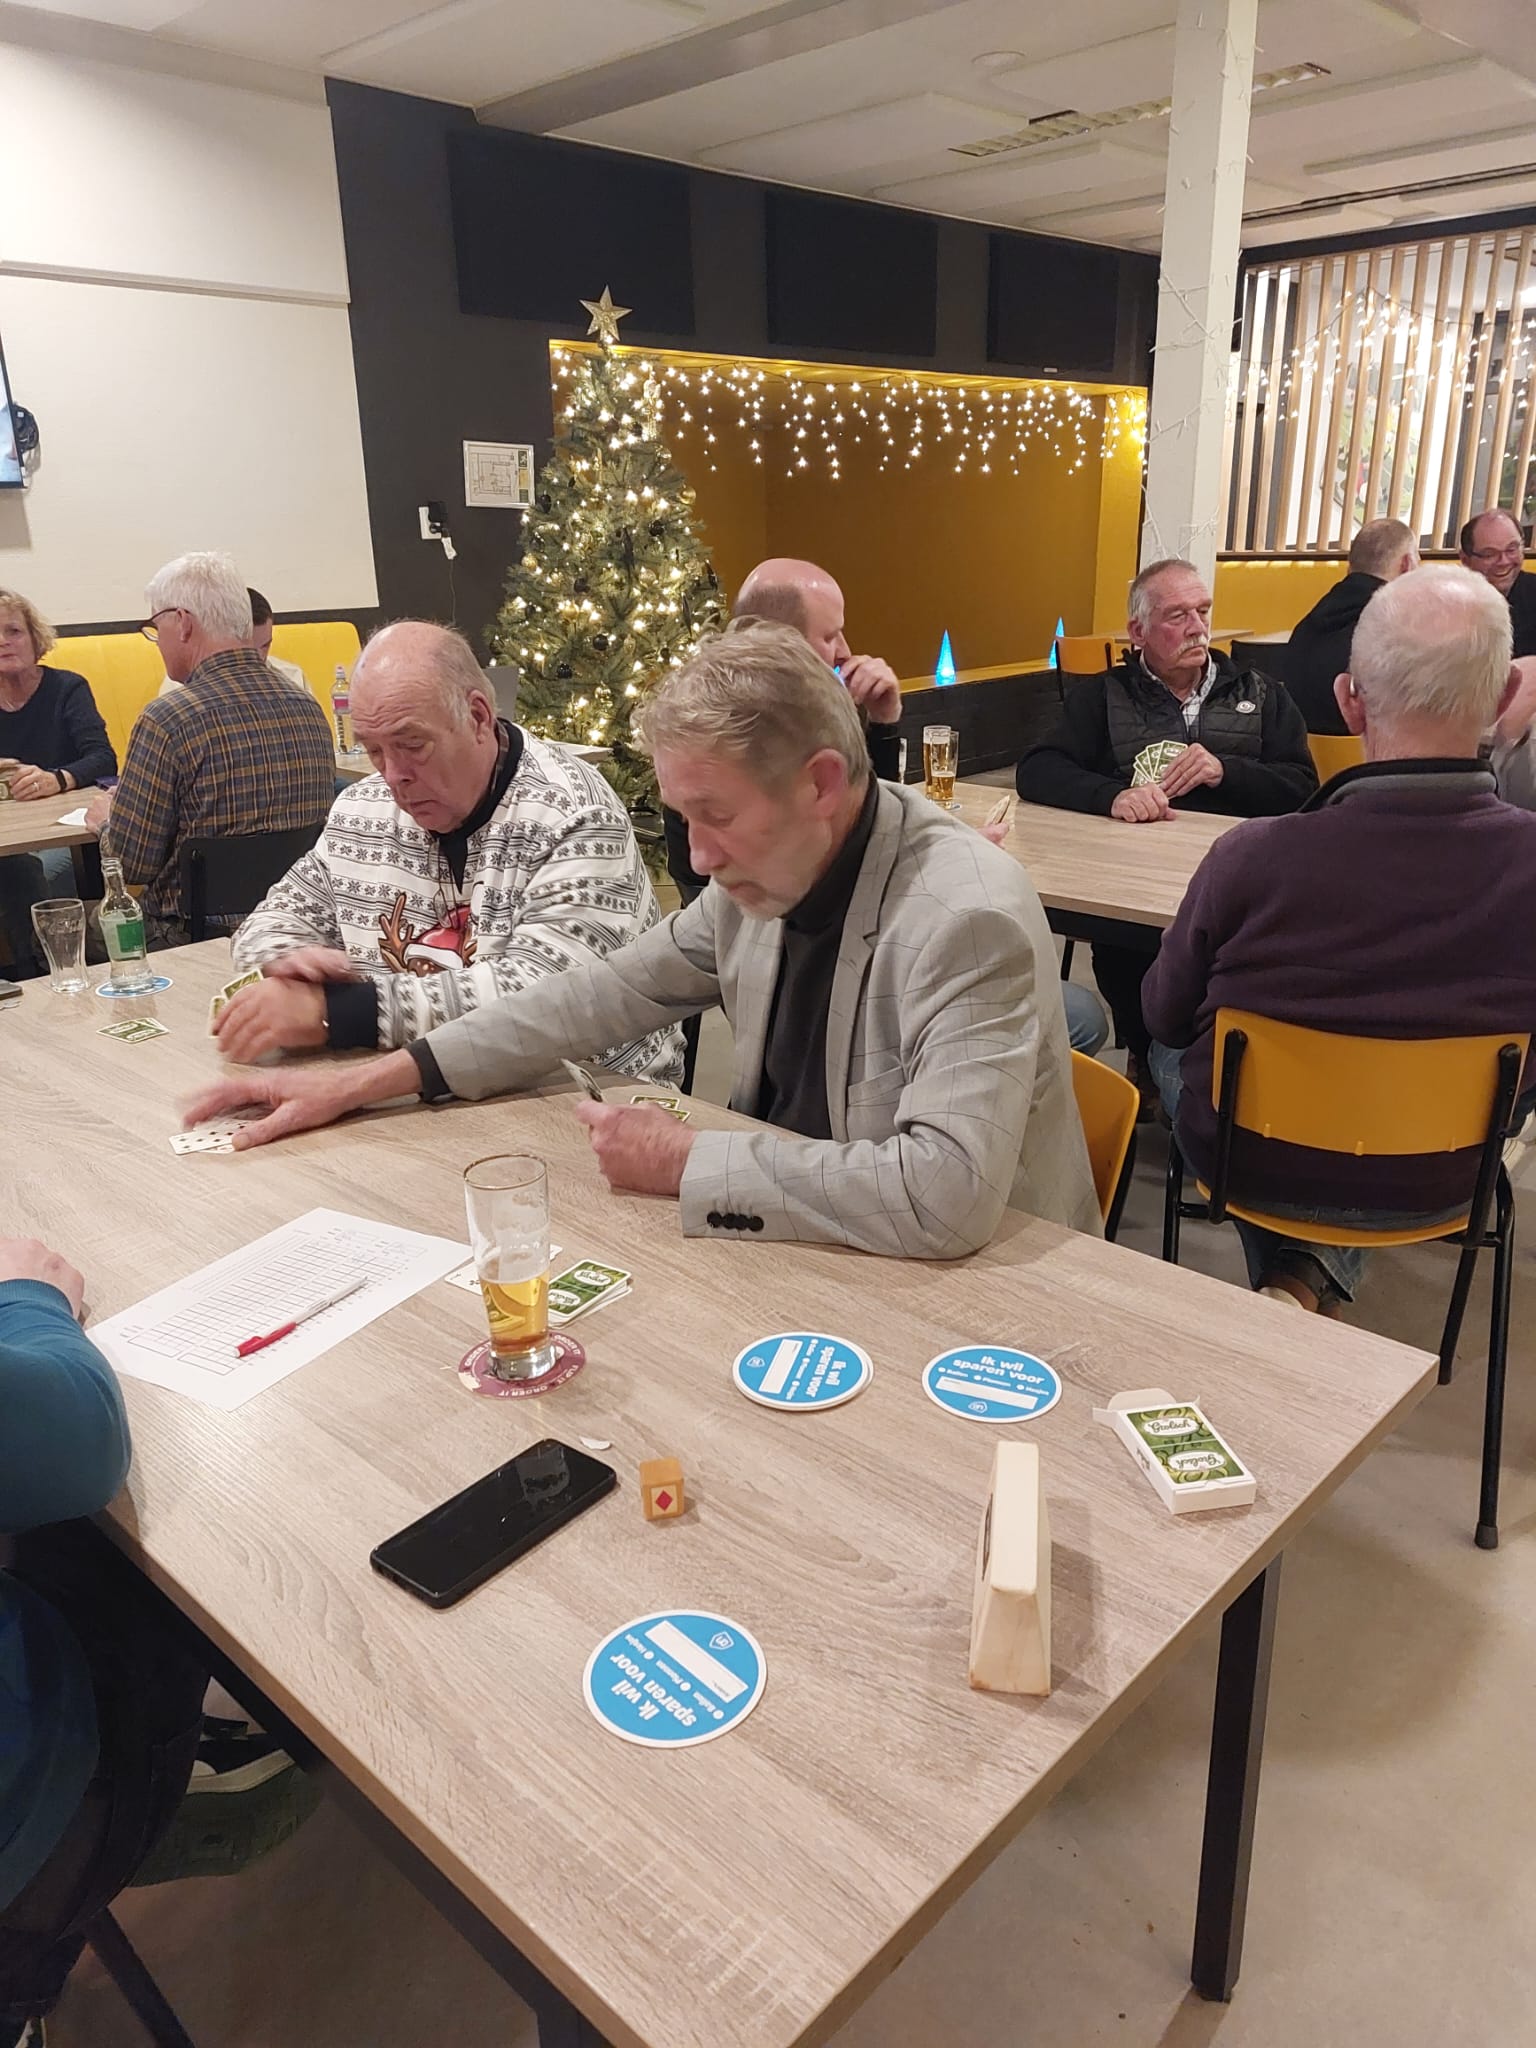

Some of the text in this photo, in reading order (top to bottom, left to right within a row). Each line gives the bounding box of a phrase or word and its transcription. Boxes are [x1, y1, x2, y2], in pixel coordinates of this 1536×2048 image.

[953, 1359, 1045, 1384] sparen voor
[981, 1356, 1025, 1372] Ik wil
[1147, 1419, 1192, 1433] Grolsch
[1175, 1453, 1222, 1469] Grolsch
[610, 1654, 646, 1684] voor
[611, 1679, 660, 1721] Ik wil
[643, 1680, 697, 1727] sparen
